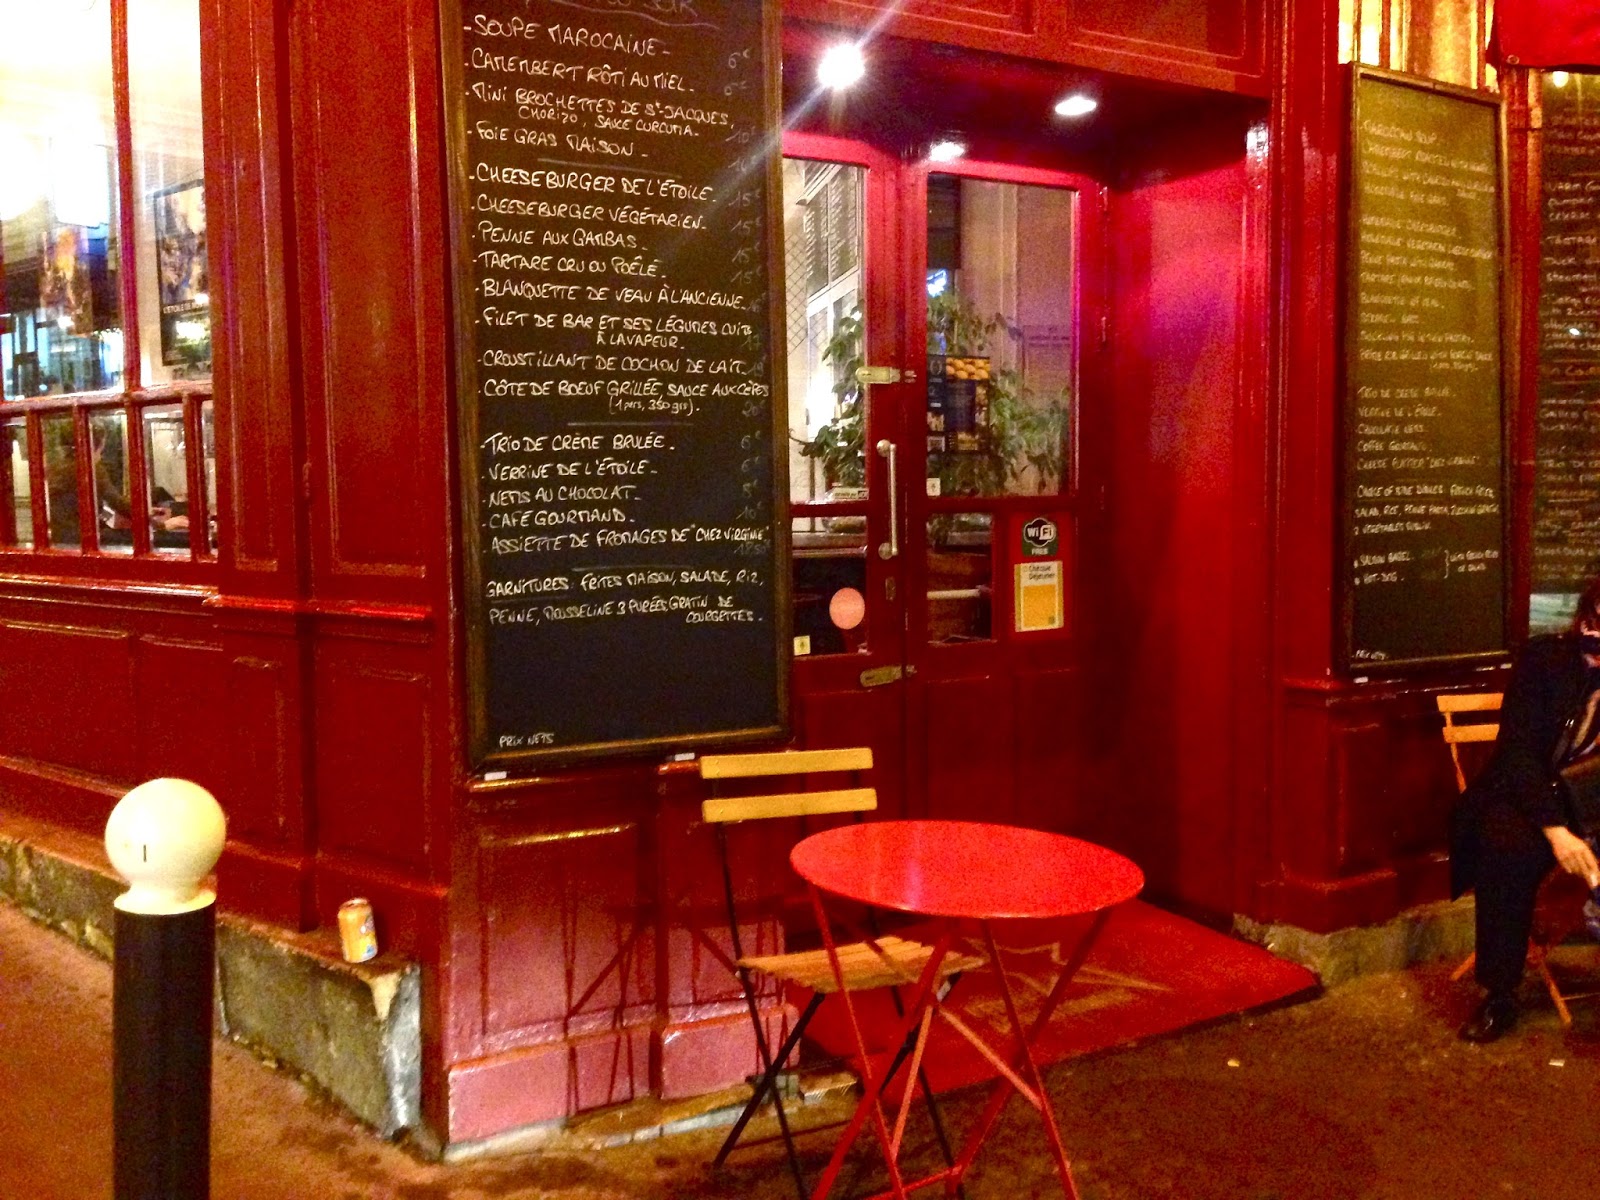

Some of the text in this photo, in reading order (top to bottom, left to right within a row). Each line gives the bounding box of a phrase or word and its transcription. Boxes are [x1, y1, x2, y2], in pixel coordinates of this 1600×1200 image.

[474, 14, 541, 40] SOUPE
[548, 24, 664, 57] MAROCAINE
[471, 47, 584, 82] CAMEMBERT
[586, 63, 628, 87] RÔTI
[630, 71, 650, 88] AU
[471, 81, 507, 102] MINI
[515, 87, 616, 113] BROCHETTES
[621, 100, 641, 116] DE
[594, 115, 633, 131] SAUCE
[475, 120, 510, 141] FOIE
[513, 128, 558, 147] GRAS
[565, 133, 634, 157] MAISON
[621, 177, 645, 196] DE
[476, 194, 612, 222] CHEESEBURGER
[477, 220, 535, 245] PENNE
[542, 230, 571, 245] AUX
[572, 227, 638, 249] GAMBAS
[478, 251, 558, 271] TARTARE
[556, 257, 585, 274] CRU
[588, 260, 607, 273] OU
[481, 278, 583, 301] BLANQUETTE
[586, 286, 611, 301] DE
[615, 287, 653, 304] VEAU
[481, 306, 530, 327] FILET
[533, 313, 558, 328] DE
[562, 313, 594, 330] BAR
[598, 315, 621, 330] ET
[622, 317, 653, 332] SES
[482, 350, 596, 371] CROUSTILLANT
[594, 355, 618, 371] DE
[621, 356, 681, 374] COCHON
[685, 358, 707, 374] DE
[531, 381, 555, 397] DE
[666, 383, 709, 398] SAUCE
[485, 432, 521, 455] TRIO
[523, 436, 549, 451] DE
[488, 463, 554, 481] VERRINE
[556, 462, 582, 476] DE
[535, 487, 553, 503] AU
[557, 485, 637, 501] CHOCOLAT
[534, 507, 627, 526] GOURMAND
[491, 535, 568, 556] ASSIETTE
[569, 532, 590, 549] DE
[596, 528, 668, 547] FROMAGES
[670, 527, 691, 543] DE
[580, 572, 623, 592] FRITES
[542, 601, 615, 621] MOUSSELINE
[668, 594, 709, 610] GRATIN
[717, 595, 734, 609] DE
